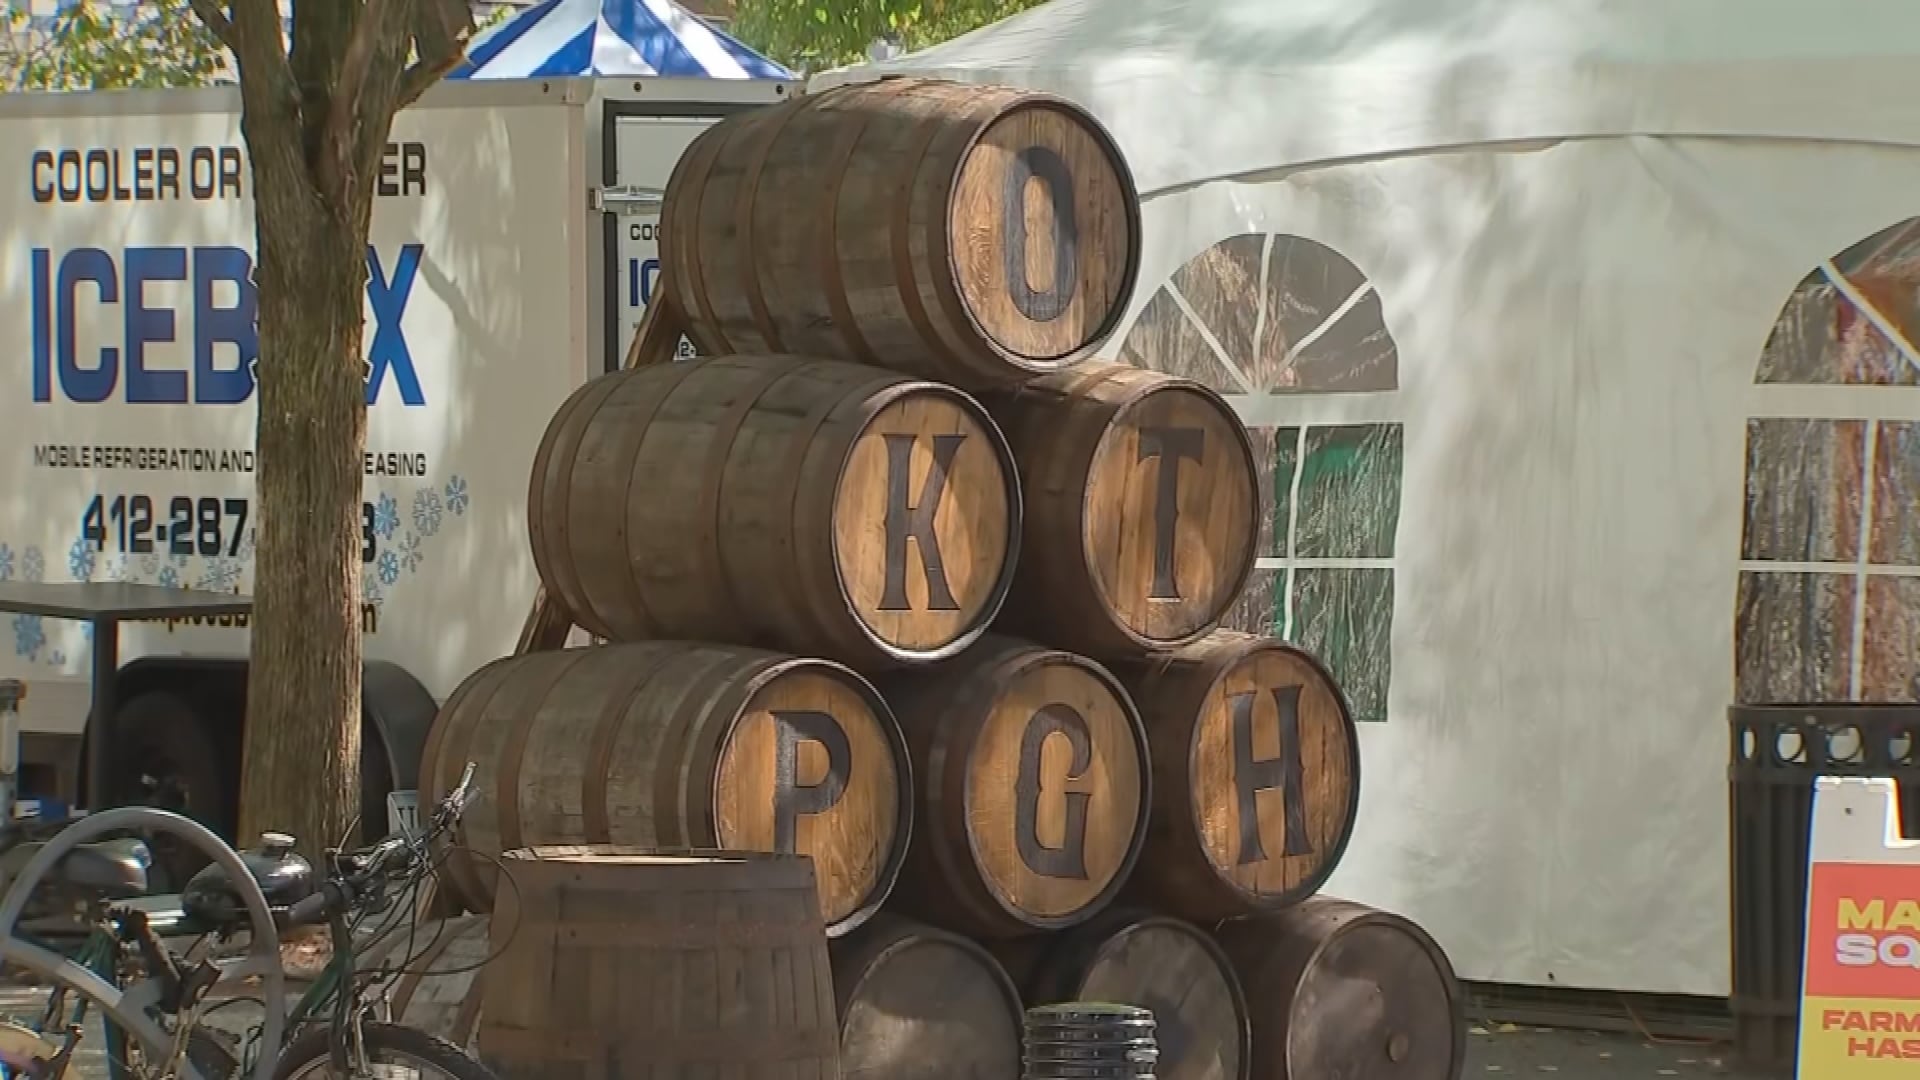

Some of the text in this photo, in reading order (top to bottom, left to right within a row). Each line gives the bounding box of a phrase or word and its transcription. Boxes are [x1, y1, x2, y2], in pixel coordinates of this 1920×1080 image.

[32, 142, 427, 202] COOLER OR ER
[1003, 145, 1077, 322] O
[31, 244, 426, 406] ICEBX
[34, 445, 427, 477] MOBILE REFRIGERATION AND EASING
[876, 426, 1205, 611] K T
[769, 683, 1312, 881] P G H
[1836, 933, 1920, 968] SQ
